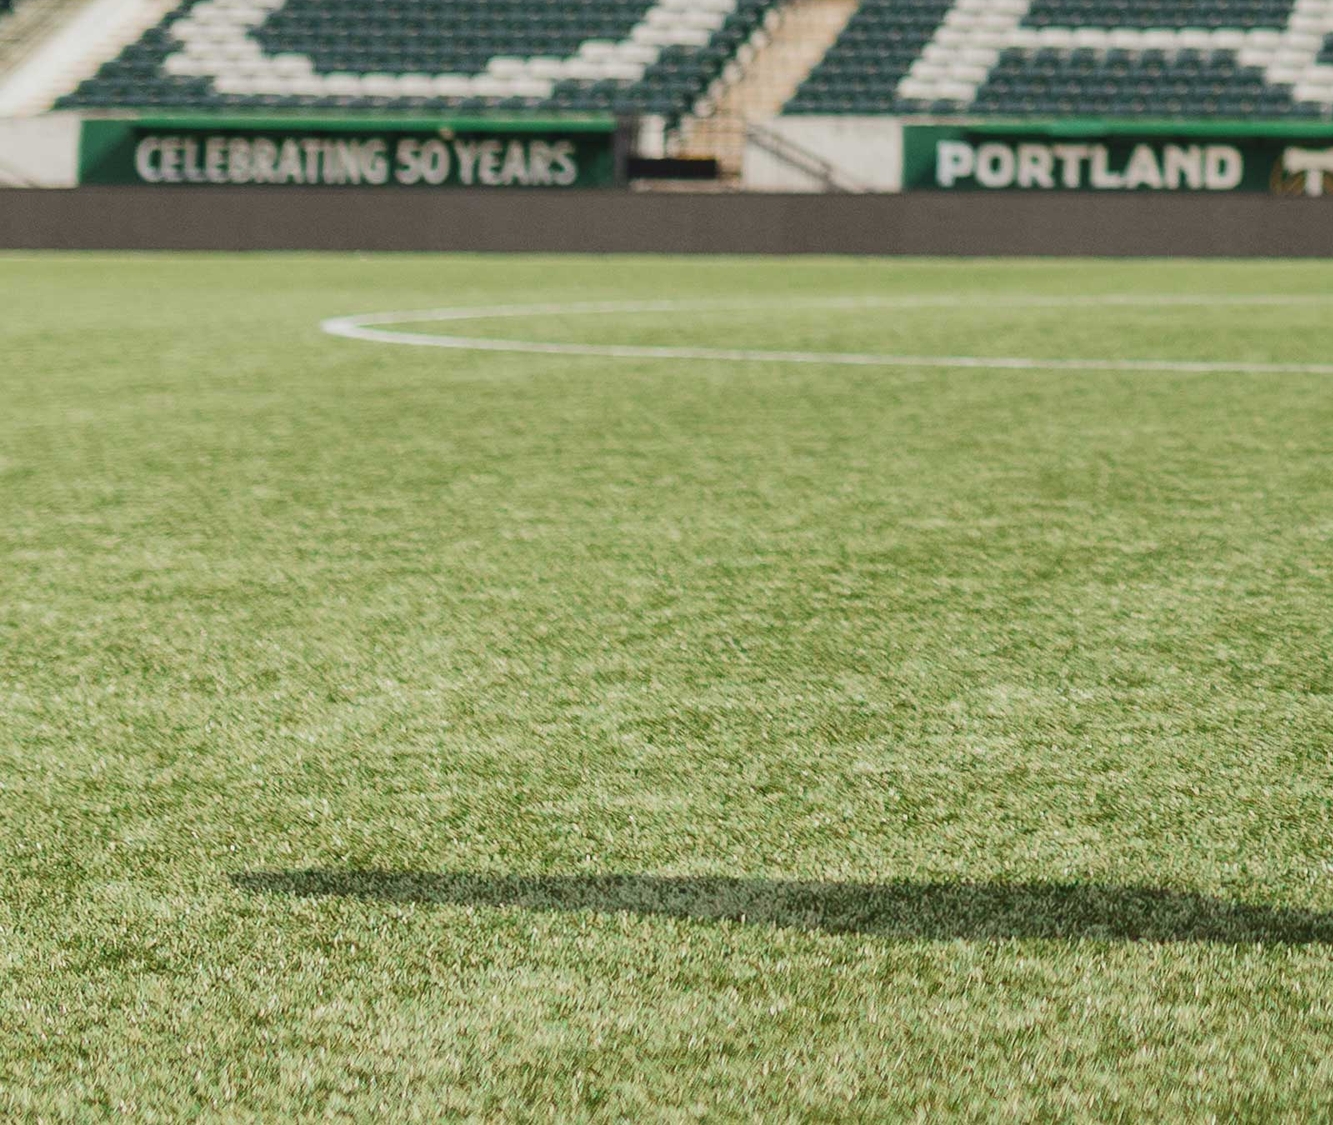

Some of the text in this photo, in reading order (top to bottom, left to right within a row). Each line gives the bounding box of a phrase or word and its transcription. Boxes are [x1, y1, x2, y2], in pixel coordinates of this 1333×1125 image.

[135, 135, 578, 188] CELEBRATING 50 YEARS
[935, 139, 1243, 191] PORTLAND
